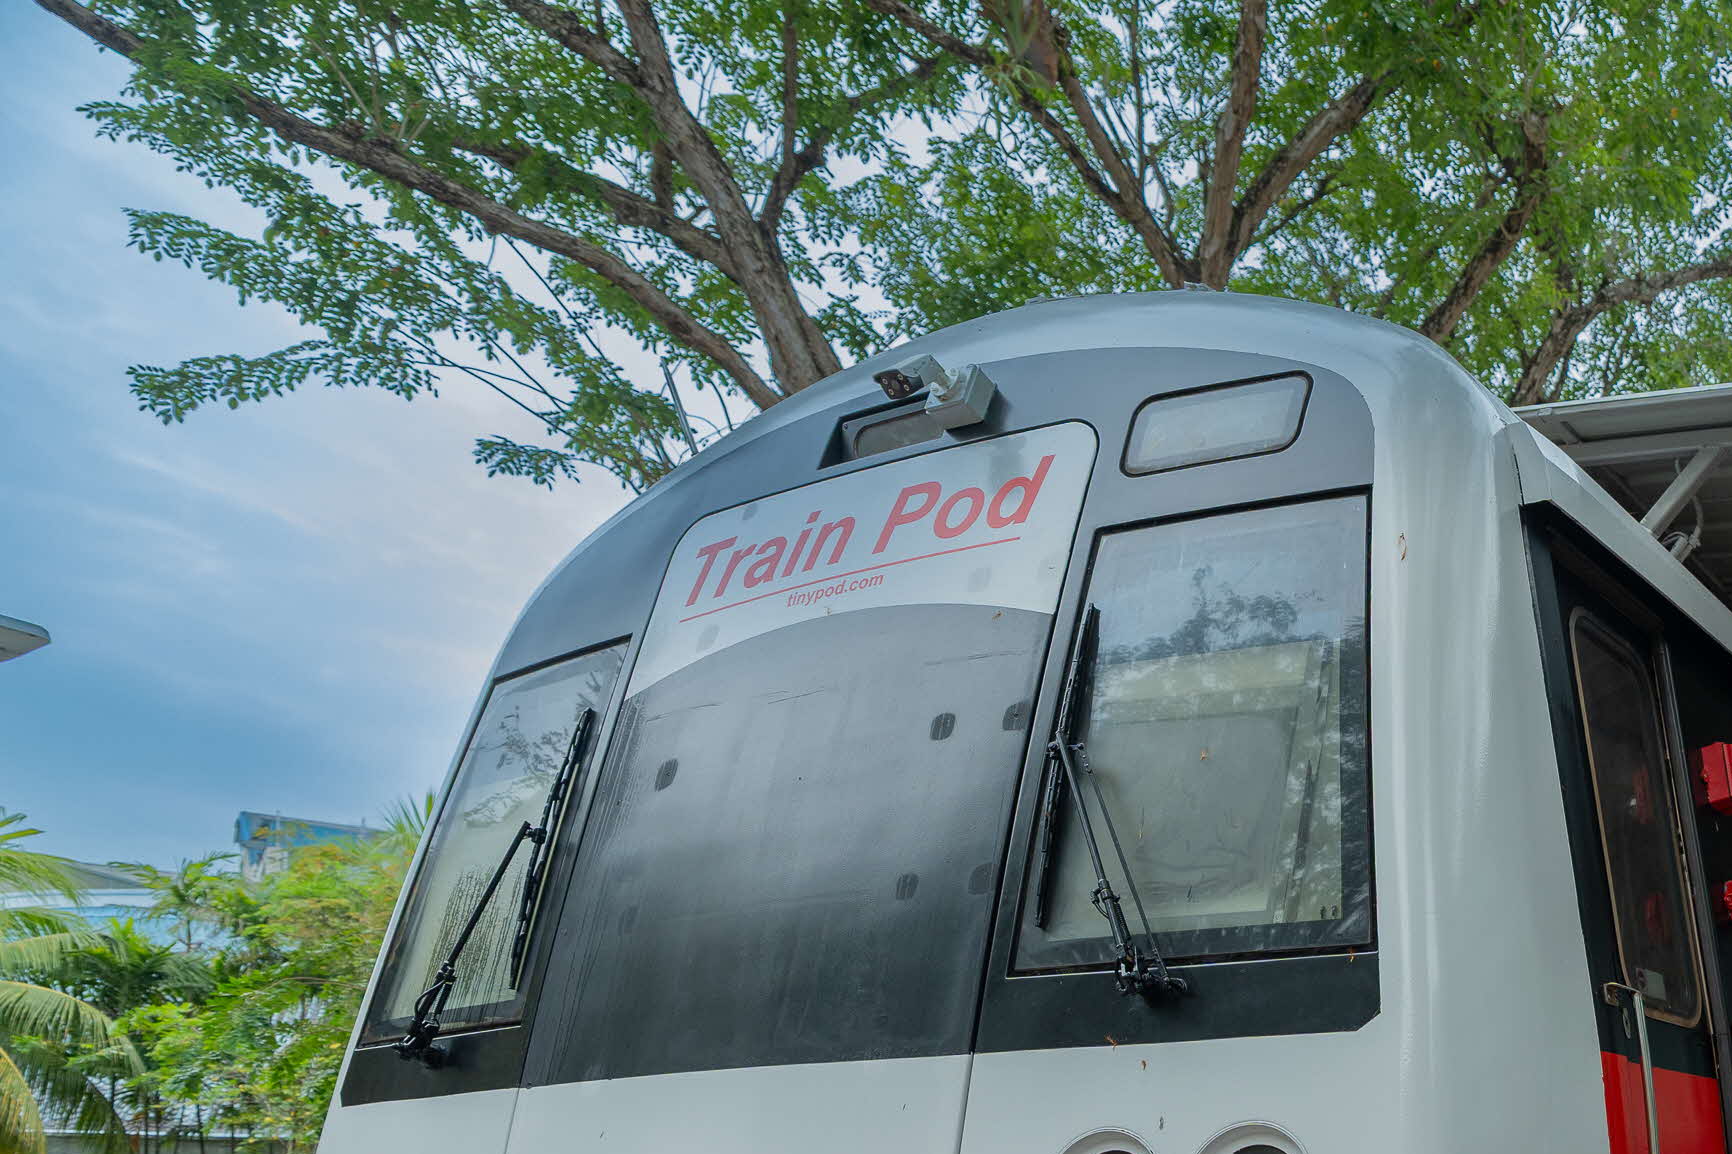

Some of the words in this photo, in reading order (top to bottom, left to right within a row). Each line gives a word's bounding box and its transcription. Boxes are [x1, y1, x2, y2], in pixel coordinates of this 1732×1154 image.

[685, 510, 856, 607] Train
[872, 454, 1055, 554] Pod
[786, 573, 884, 607] tinypod.com
